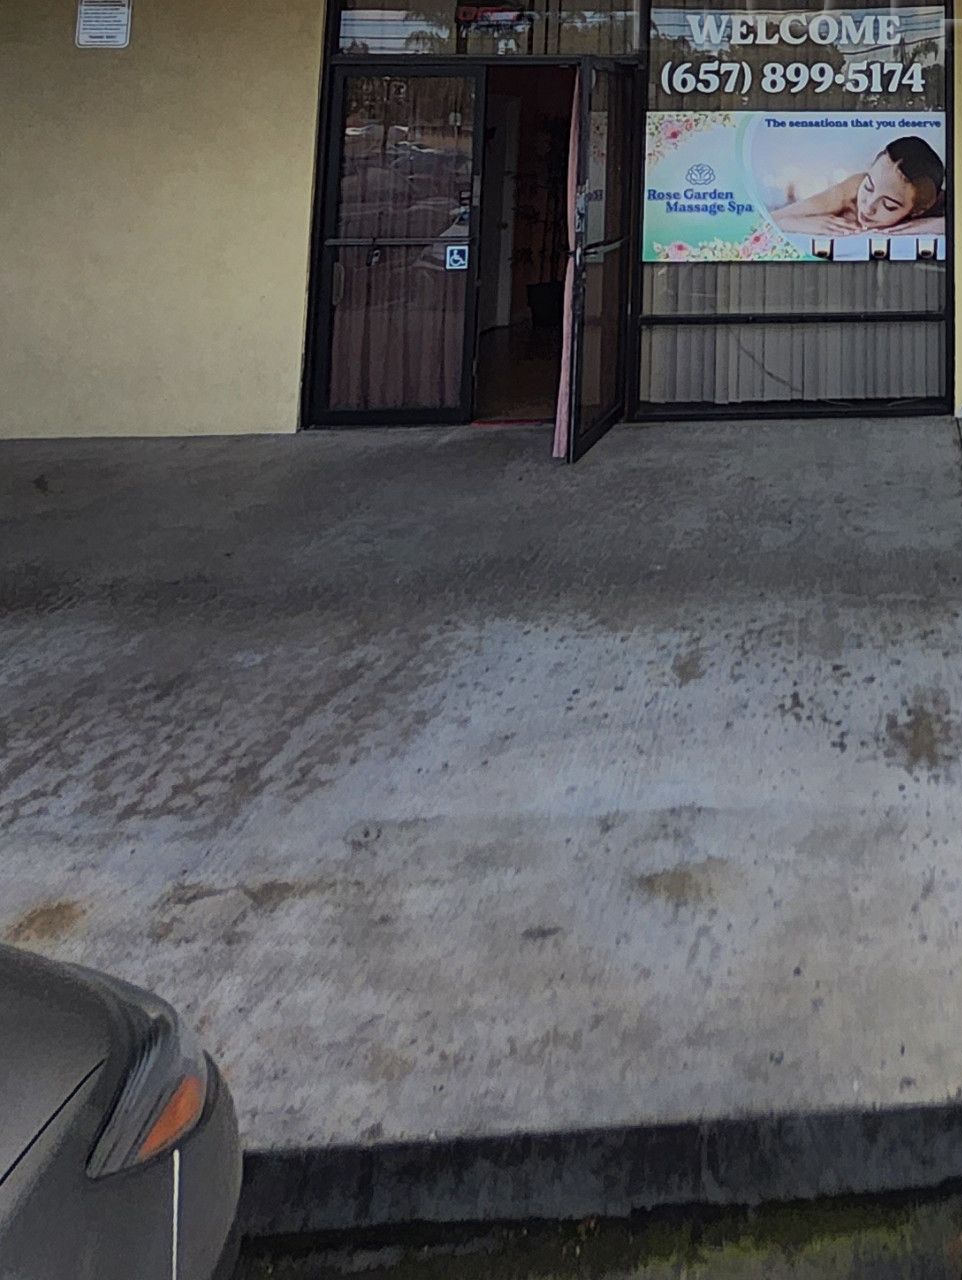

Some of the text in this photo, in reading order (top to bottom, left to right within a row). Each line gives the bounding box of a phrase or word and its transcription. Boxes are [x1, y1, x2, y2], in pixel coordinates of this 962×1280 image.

[686, 14, 901, 45] WELCOME
[661, 60, 752, 95] (657)
[765, 118, 942, 130] The sensations that you deserve
[647, 188, 734, 200] Rose Garden
[666, 201, 753, 216] Massage Spa
